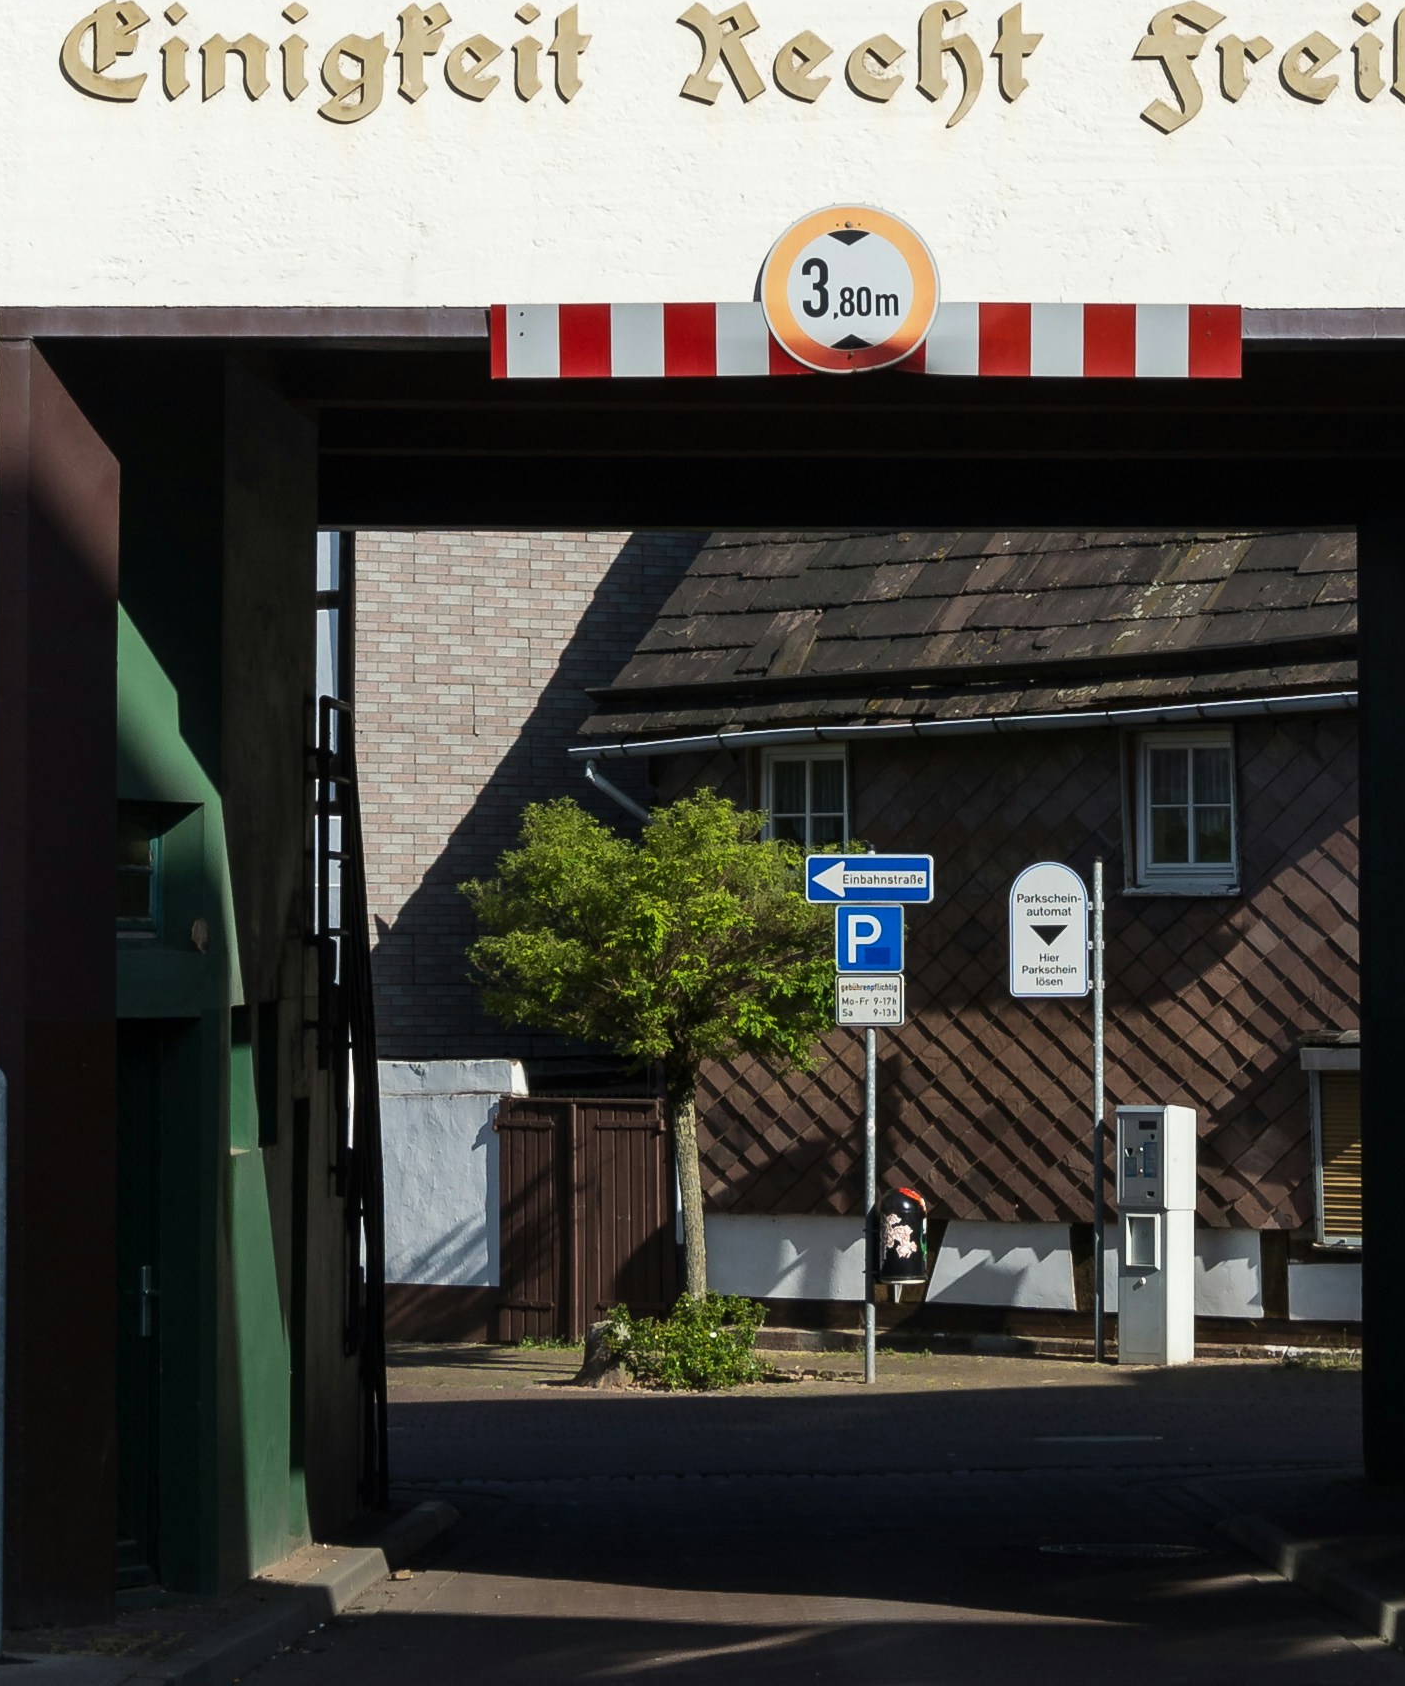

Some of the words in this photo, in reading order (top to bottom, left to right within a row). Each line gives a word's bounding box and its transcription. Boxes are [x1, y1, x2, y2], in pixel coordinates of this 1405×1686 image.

[675, 0, 1044, 129] Recht
[842, 873, 923, 885] Einbahnstraße
[1016, 893, 1082, 905] Parkschein-
[1026, 906, 1072, 917] automat
[848, 915, 882, 963] P
[1039, 953, 1060, 963] Hier
[1021, 965, 1077, 975] Parkschein
[1035, 977, 1063, 987] lösen
[842, 1008, 854, 1017] Sa
